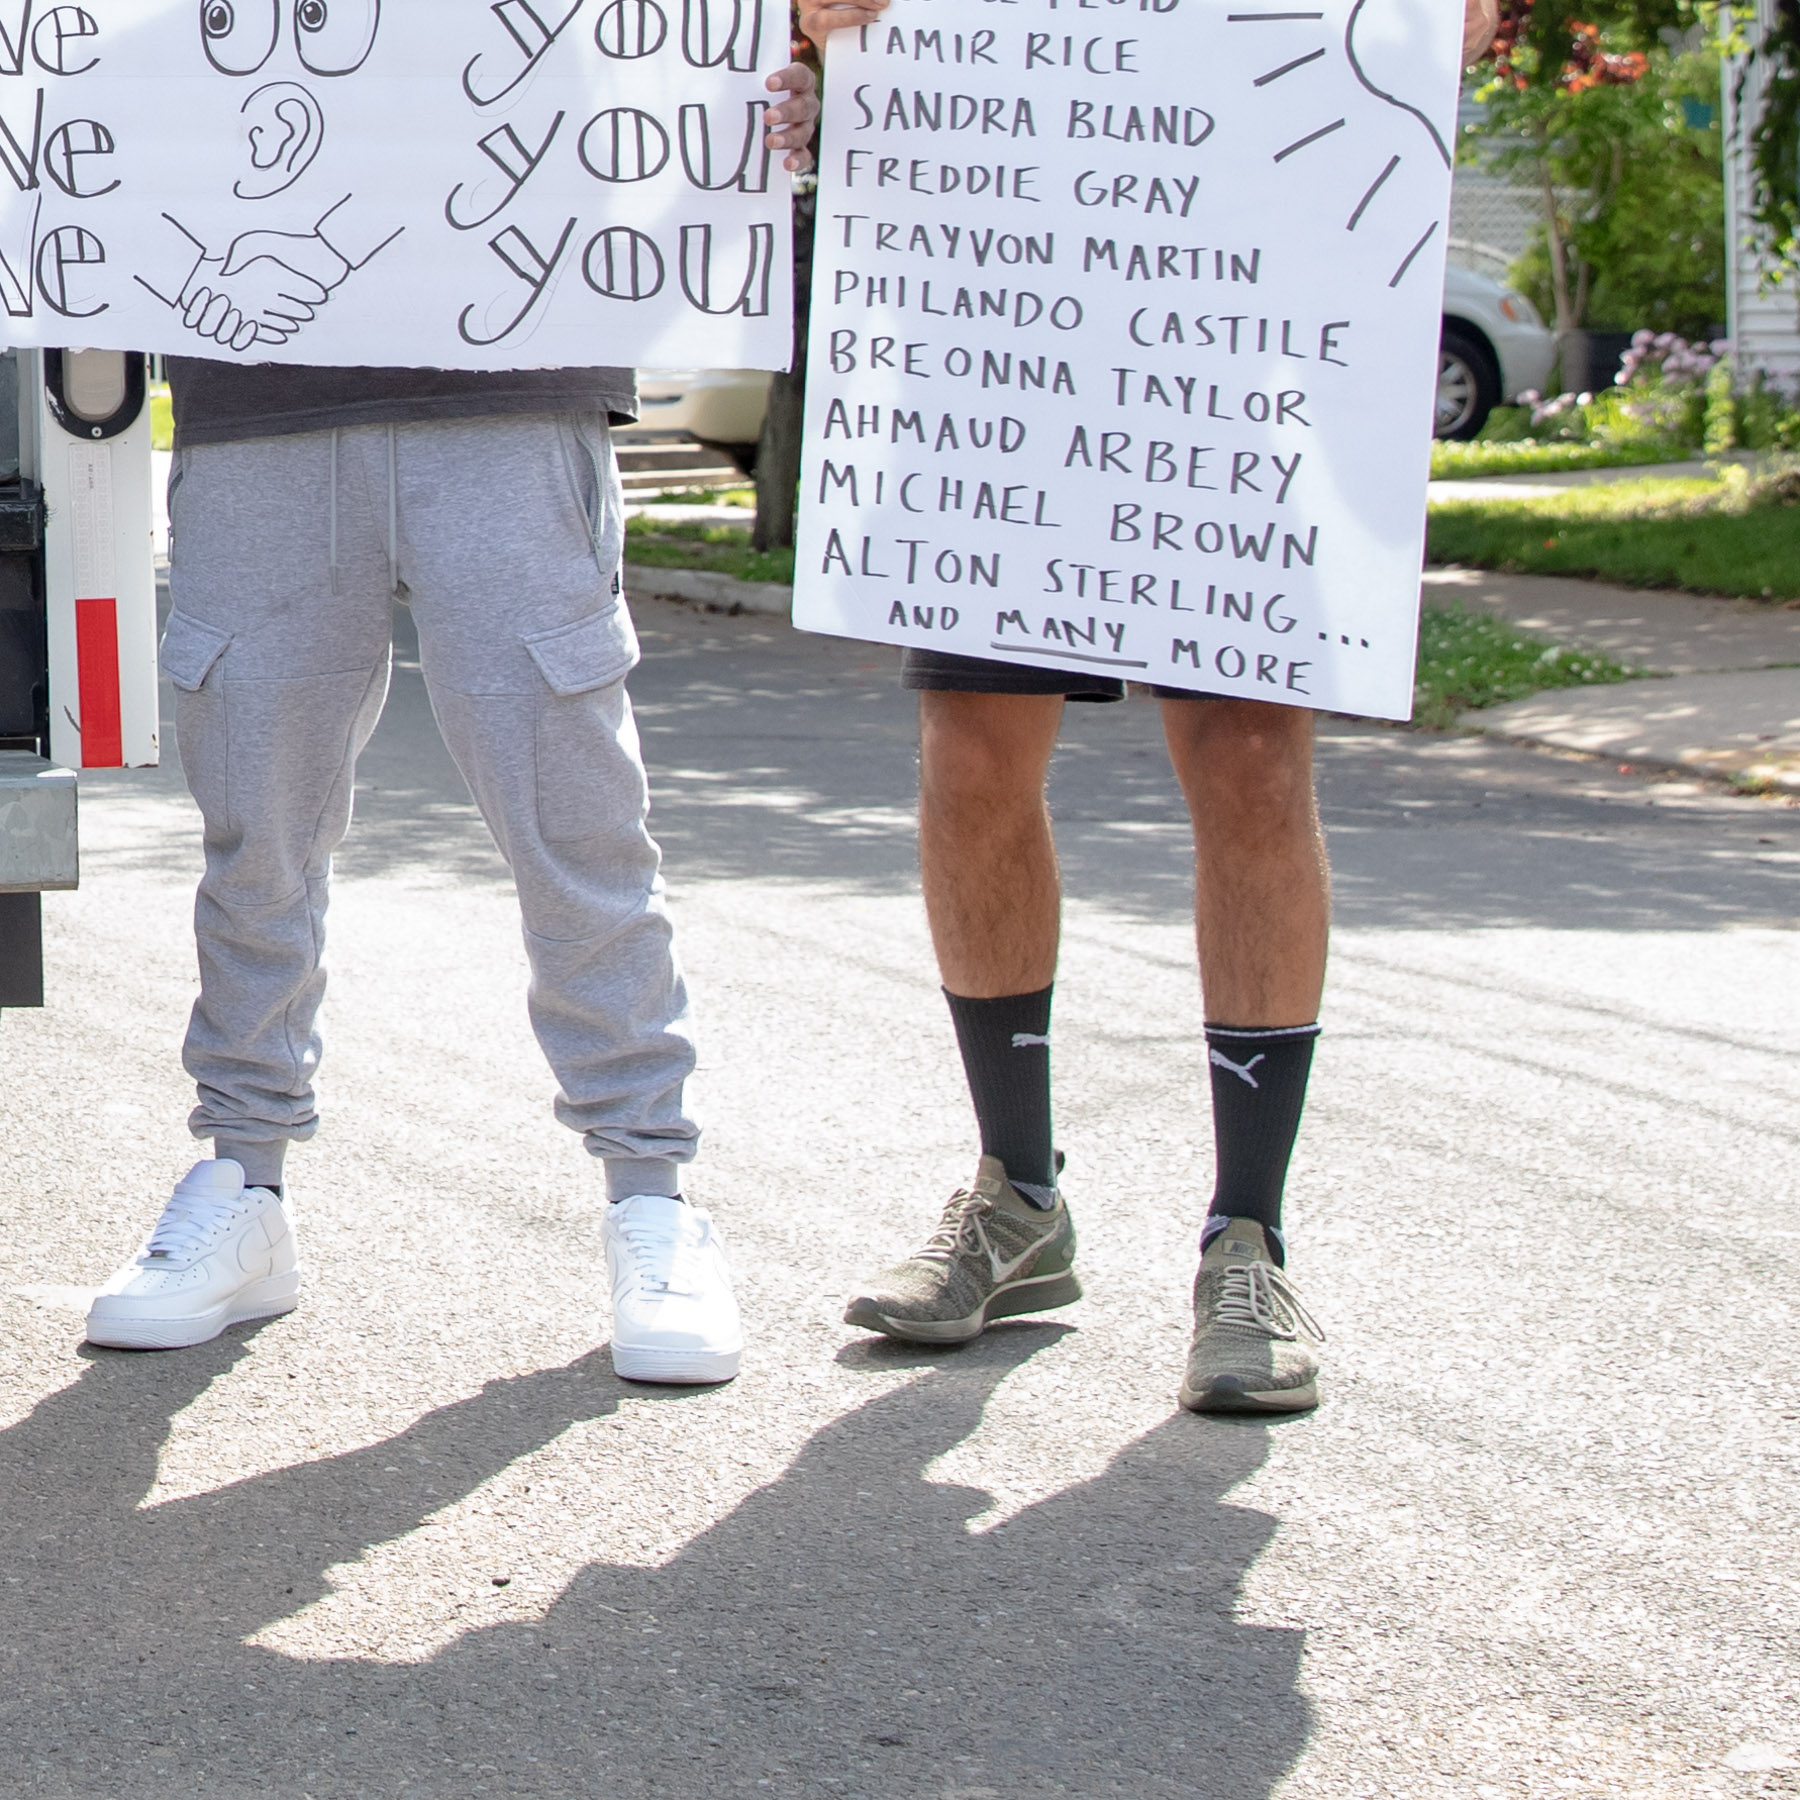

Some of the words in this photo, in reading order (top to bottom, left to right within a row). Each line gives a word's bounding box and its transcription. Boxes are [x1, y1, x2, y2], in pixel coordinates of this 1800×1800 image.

[1025, 33, 1140, 75] RICE
[853, 83, 1036, 139] SANDRA
[1068, 100, 1216, 148] BLAND
[445, 100, 770, 231] you
[845, 149, 1041, 202] FREDDIE
[1074, 171, 1199, 218] GRAY
[457, 216, 773, 348] you
[833, 214, 1054, 266] TRAYVON
[1083, 238, 1261, 284] MARTIN
[834, 270, 1083, 331] PHILANDO
[1129, 307, 1350, 366] CASTILE
[831, 328, 1076, 395] BREONNA
[1111, 368, 1312, 428] TAYLOR
[823, 398, 1026, 454] AHMAUD
[1064, 425, 1302, 504] ARBERY
[818, 459, 1061, 528] MICHAEL
[1110, 503, 1319, 570] BROWN
[822, 528, 1000, 588] ALTON
[888, 600, 958, 631] AND
[996, 609, 1126, 653] MANY
[1172, 638, 1313, 695] MORE
